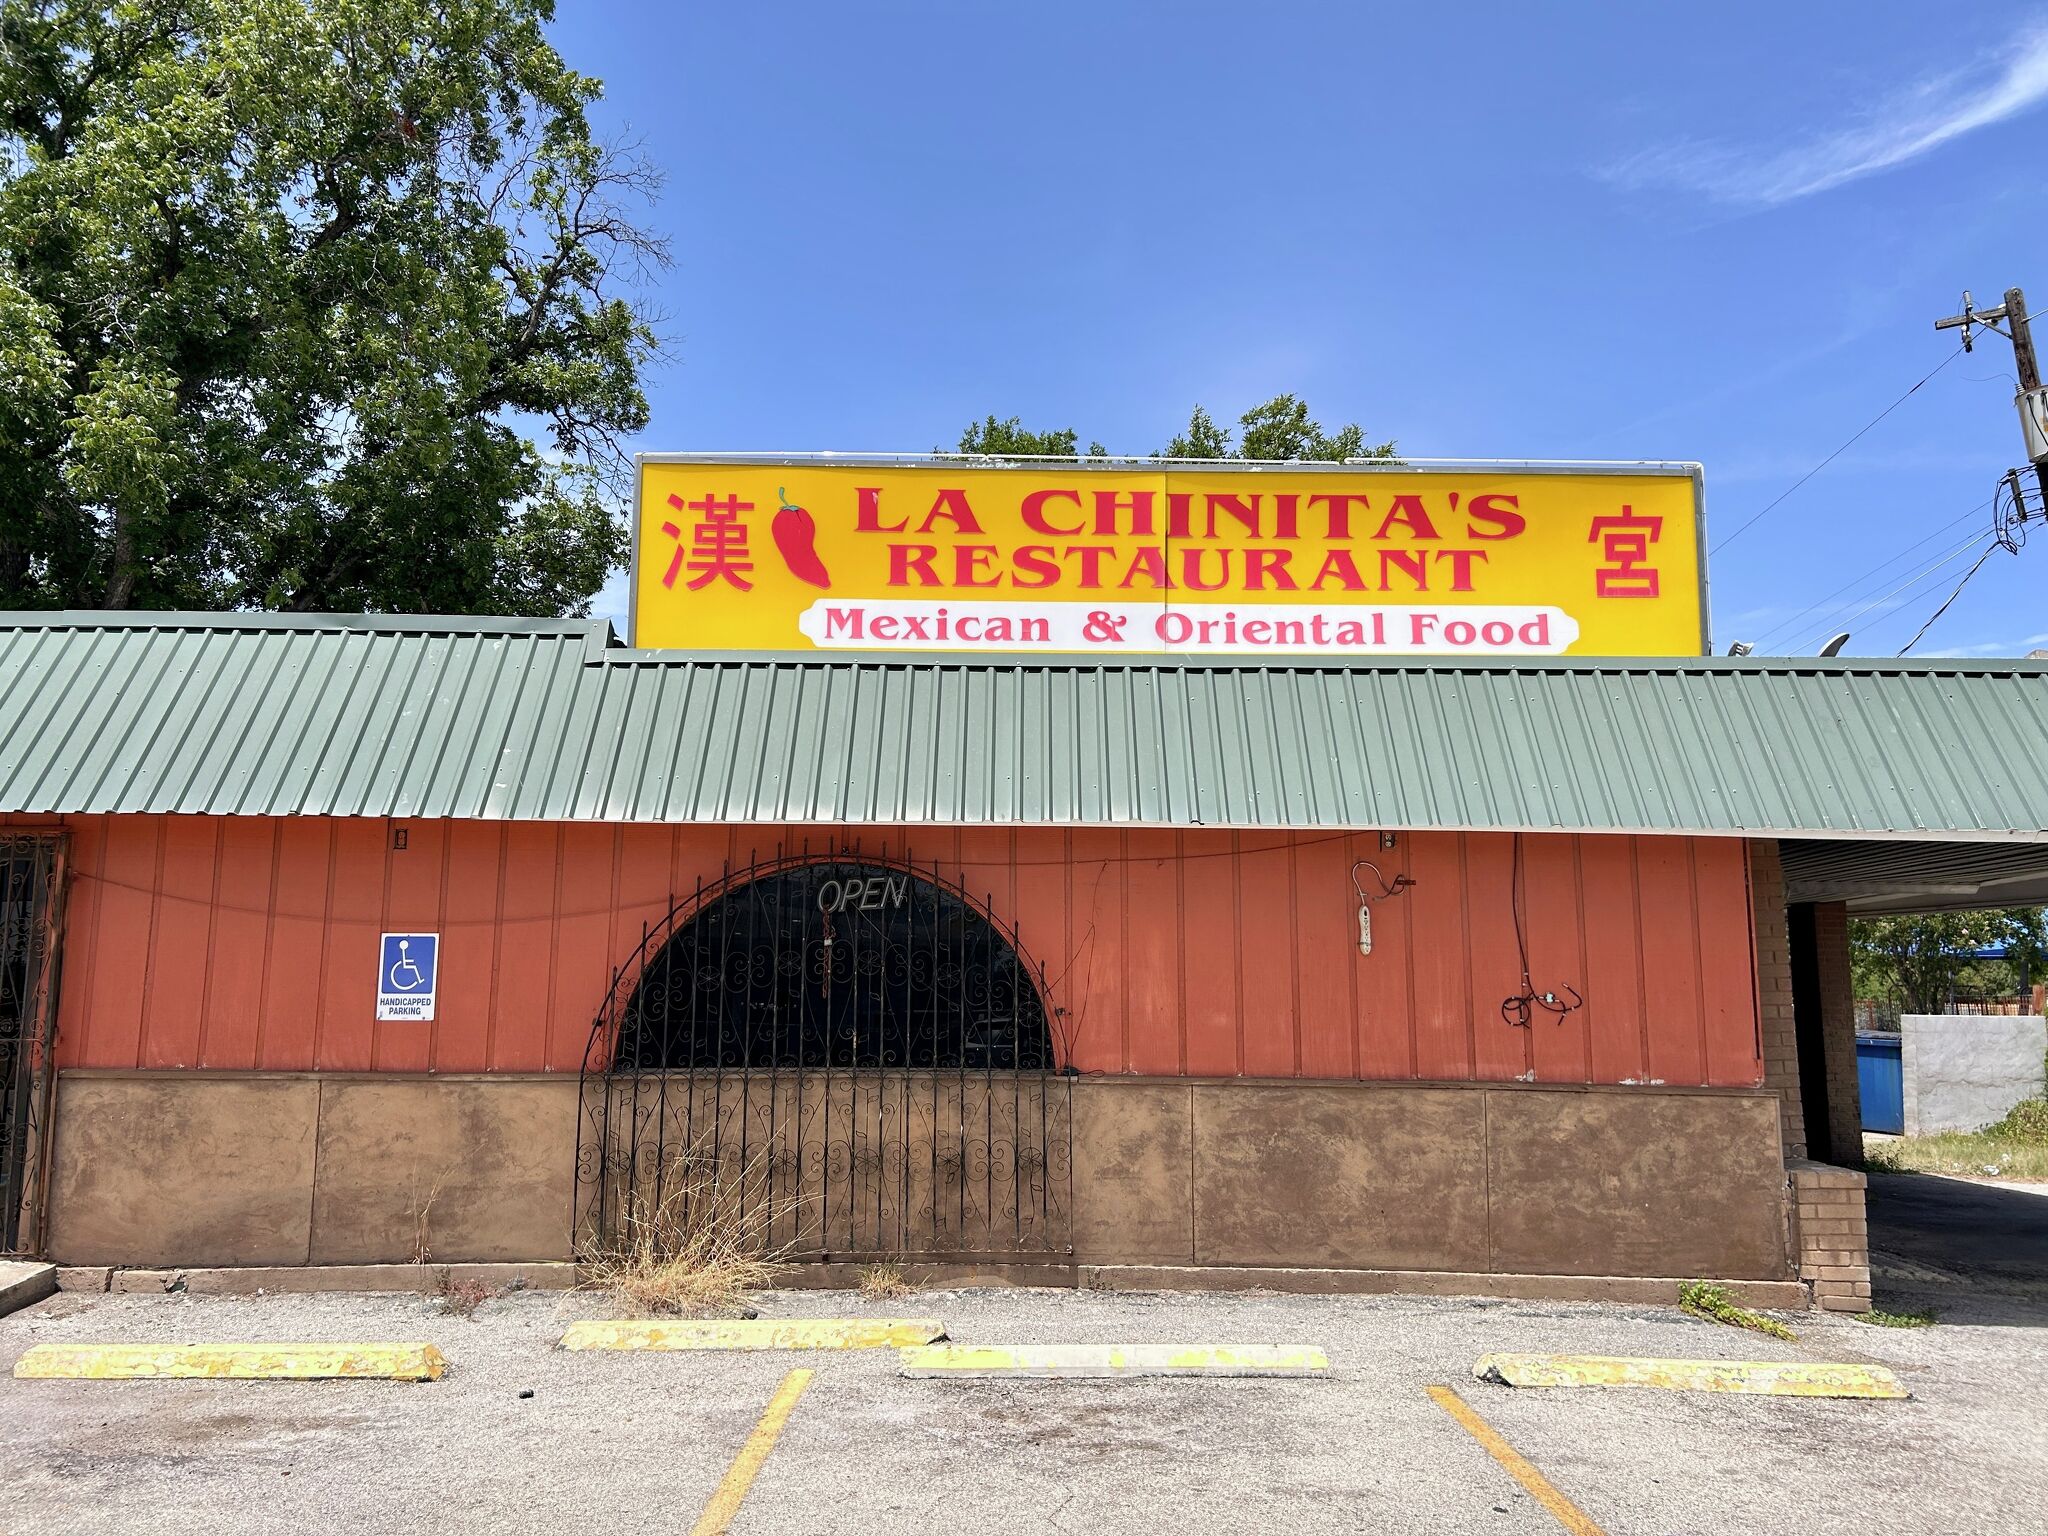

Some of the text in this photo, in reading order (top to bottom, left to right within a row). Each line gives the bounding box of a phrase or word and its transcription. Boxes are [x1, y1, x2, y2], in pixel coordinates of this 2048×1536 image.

[853, 486, 1528, 541] LA CHINITA'S
[661, 492, 757, 592] 漢
[1587, 504, 1666, 598] 宮
[885, 544, 1490, 594] RESTAURANT
[823, 608, 1550, 647] Mexican & Oriental Food
[817, 875, 908, 913] OPEN
[379, 997, 432, 1006] HANDICAPPED
[388, 1006, 421, 1015] PARKING
